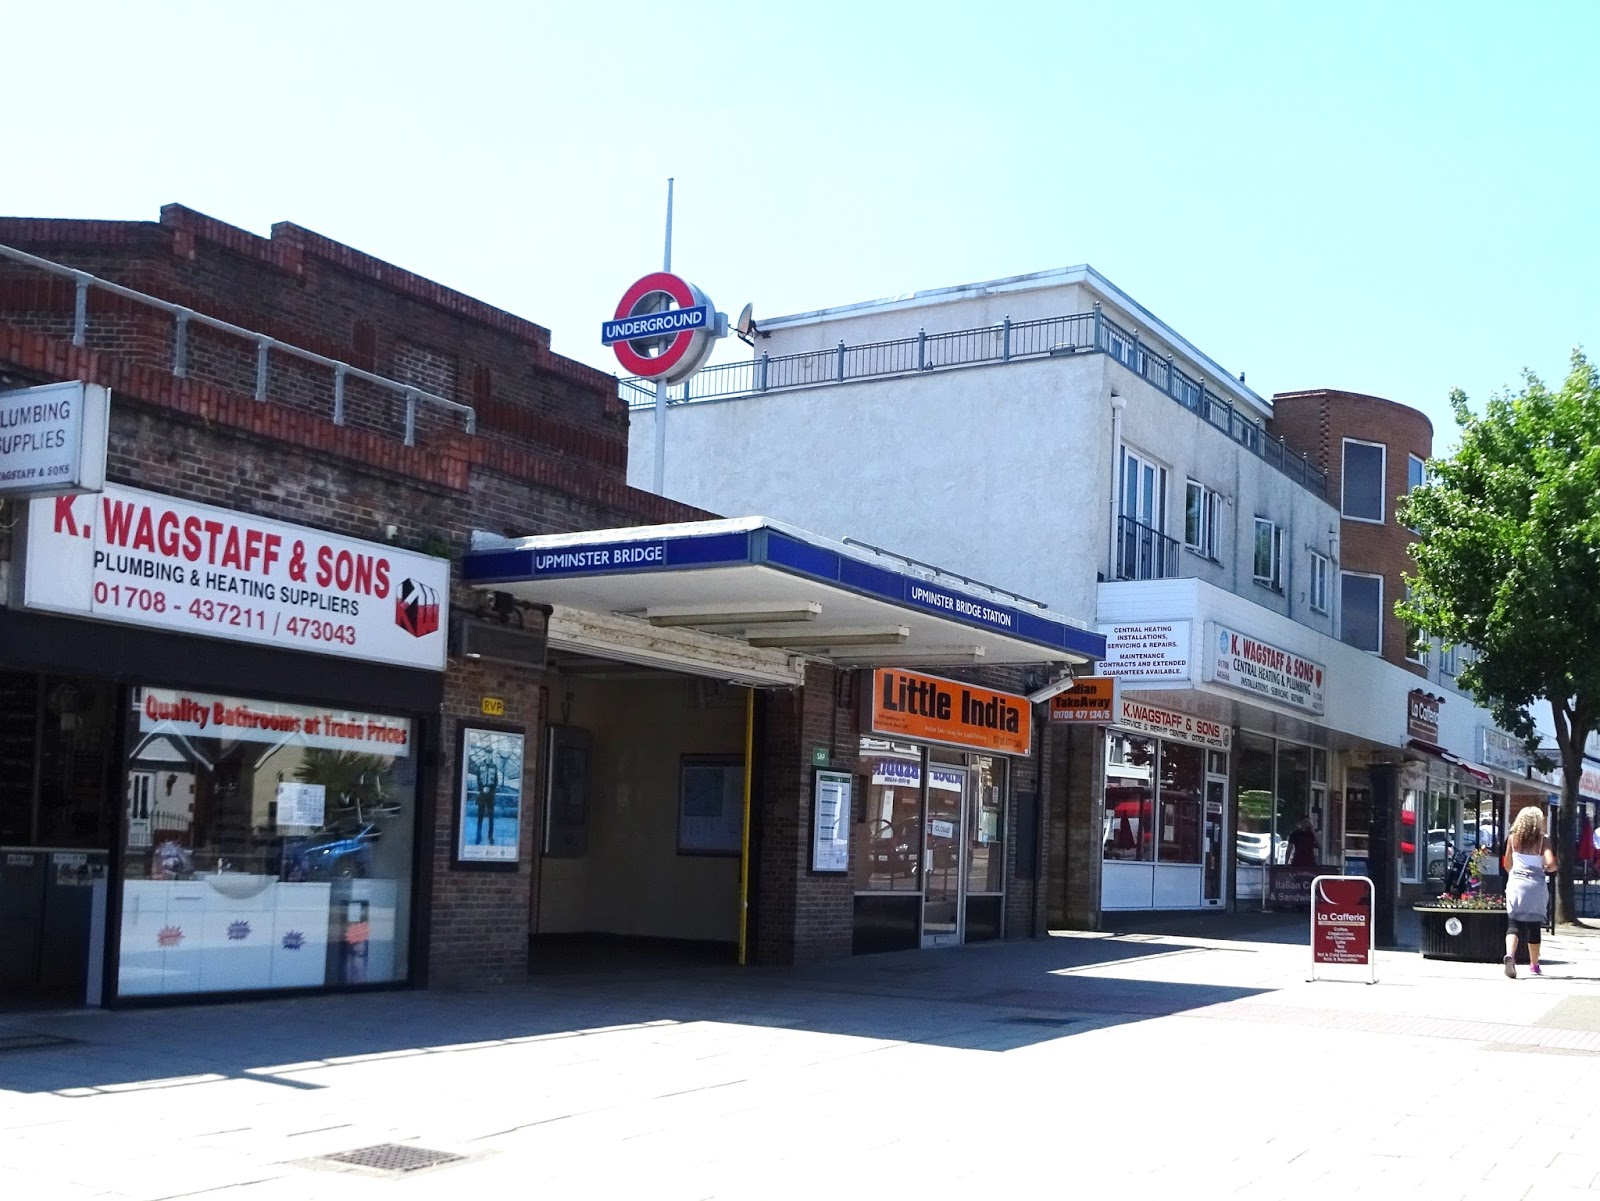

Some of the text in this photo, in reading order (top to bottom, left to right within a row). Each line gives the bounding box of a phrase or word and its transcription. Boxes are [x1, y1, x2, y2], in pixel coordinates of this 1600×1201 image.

[606, 310, 703, 338] UNDERGROUND
[0, 400, 71, 428] LUMBING
[0, 464, 70, 481] AGSTAFF & SONS
[54, 494, 390, 600] K. WAGSTAFF & SONS
[536, 546, 663, 570] UPMINSTER BRIDGE
[94, 550, 360, 616] PLUMBING & HEATING SUPPLIERS
[94, 581, 166, 614] 01708
[188, 598, 265, 630] 437211
[286, 616, 357, 646] 473043
[911, 586, 1012, 627] UPMINSTER BRIDGE STATION
[1230, 633, 1314, 683] K. WAGSTAFF & SONS
[1232, 658, 1258, 678] CENTRAL
[1258, 666, 1280, 686] HEATING
[1286, 676, 1311, 696] PLUMBING
[1240, 676, 1269, 694] INSTALLATIONS
[484, 700, 503, 712] RVP
[884, 672, 1020, 734] Little India
[145, 694, 408, 745] Quality Bathrooms at Trade Prices
[1120, 718, 1142, 730] SERVICE
[1150, 724, 1168, 735] REPAIR
[1169, 729, 1188, 740] CENTRE
[1186, 718, 1192, 731] &
[1196, 720, 1220, 738] SONS
[1318, 912, 1328, 920] La
